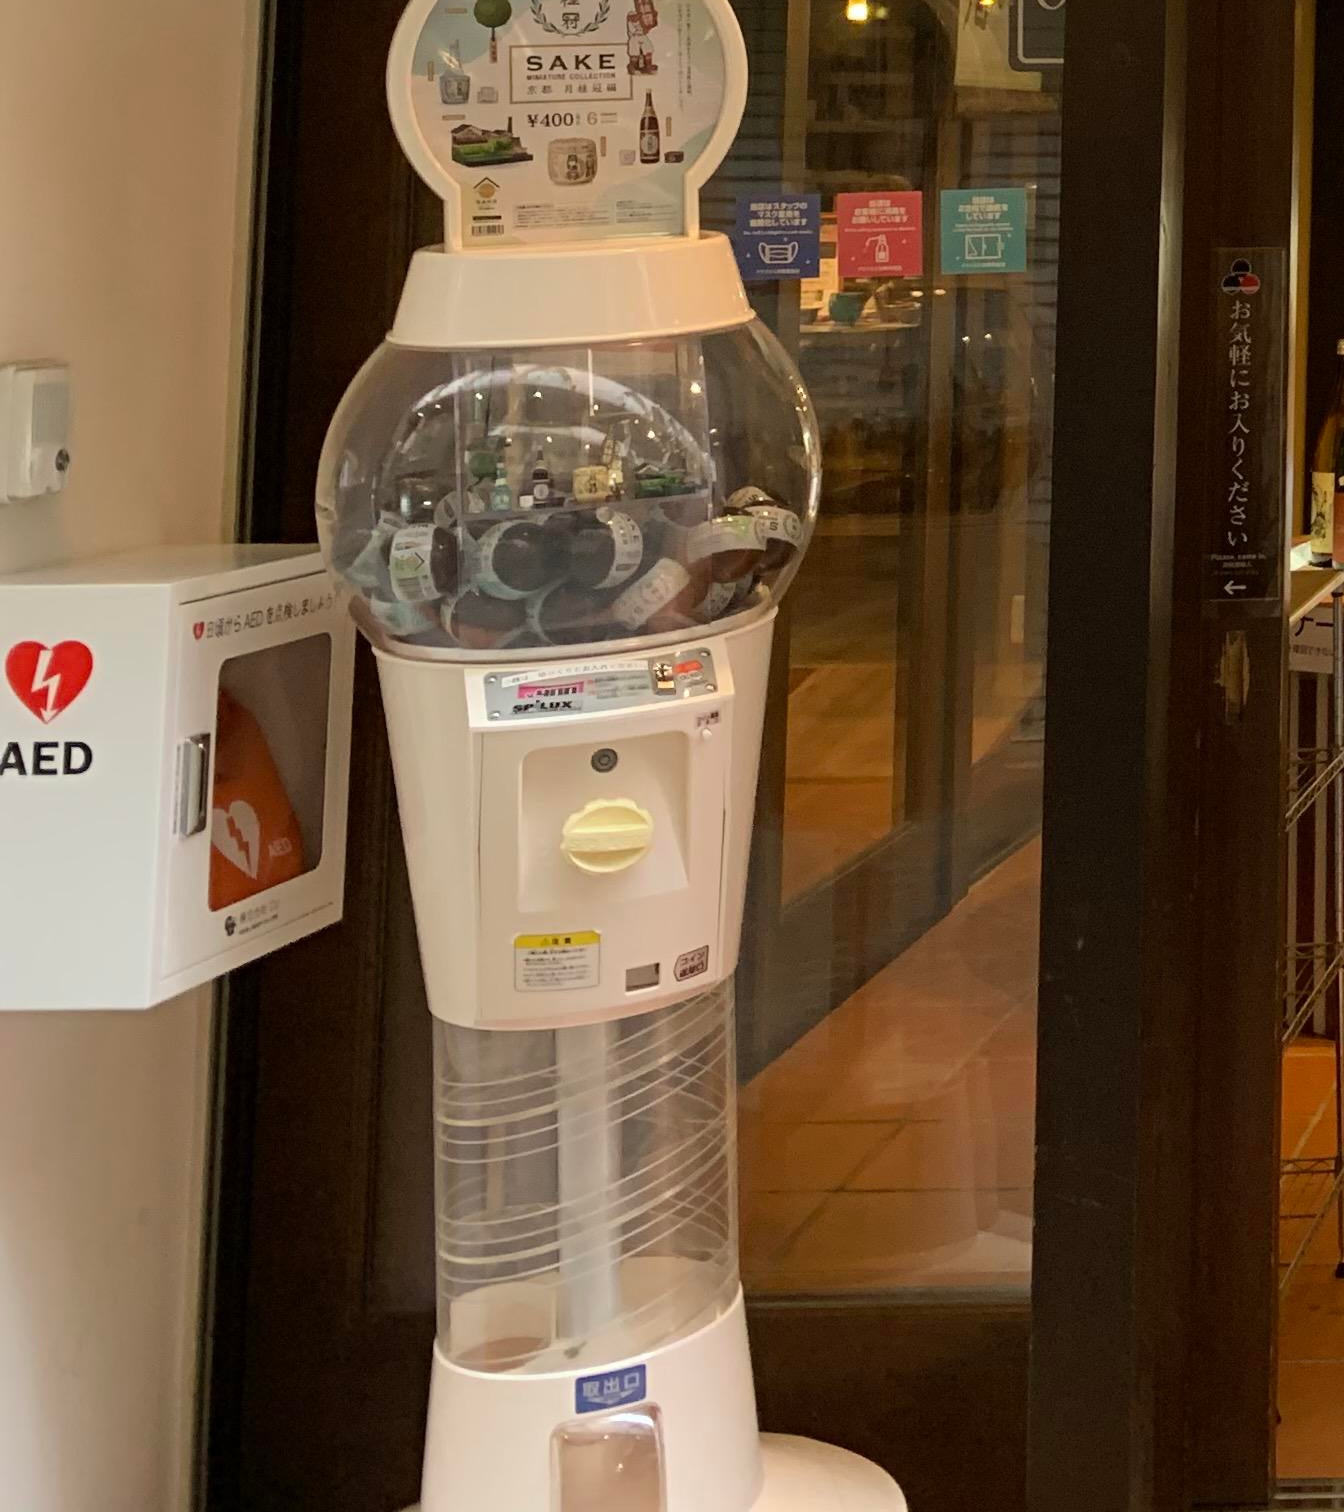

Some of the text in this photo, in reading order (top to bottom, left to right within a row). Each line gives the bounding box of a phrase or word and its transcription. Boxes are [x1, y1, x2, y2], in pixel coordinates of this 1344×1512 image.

[527, 54, 615, 71] SAKE
[1228, 299, 1252, 547] お気軽にお入りください
[0, 741, 93, 776] AED
[582, 1371, 640, 1398] 取出口
